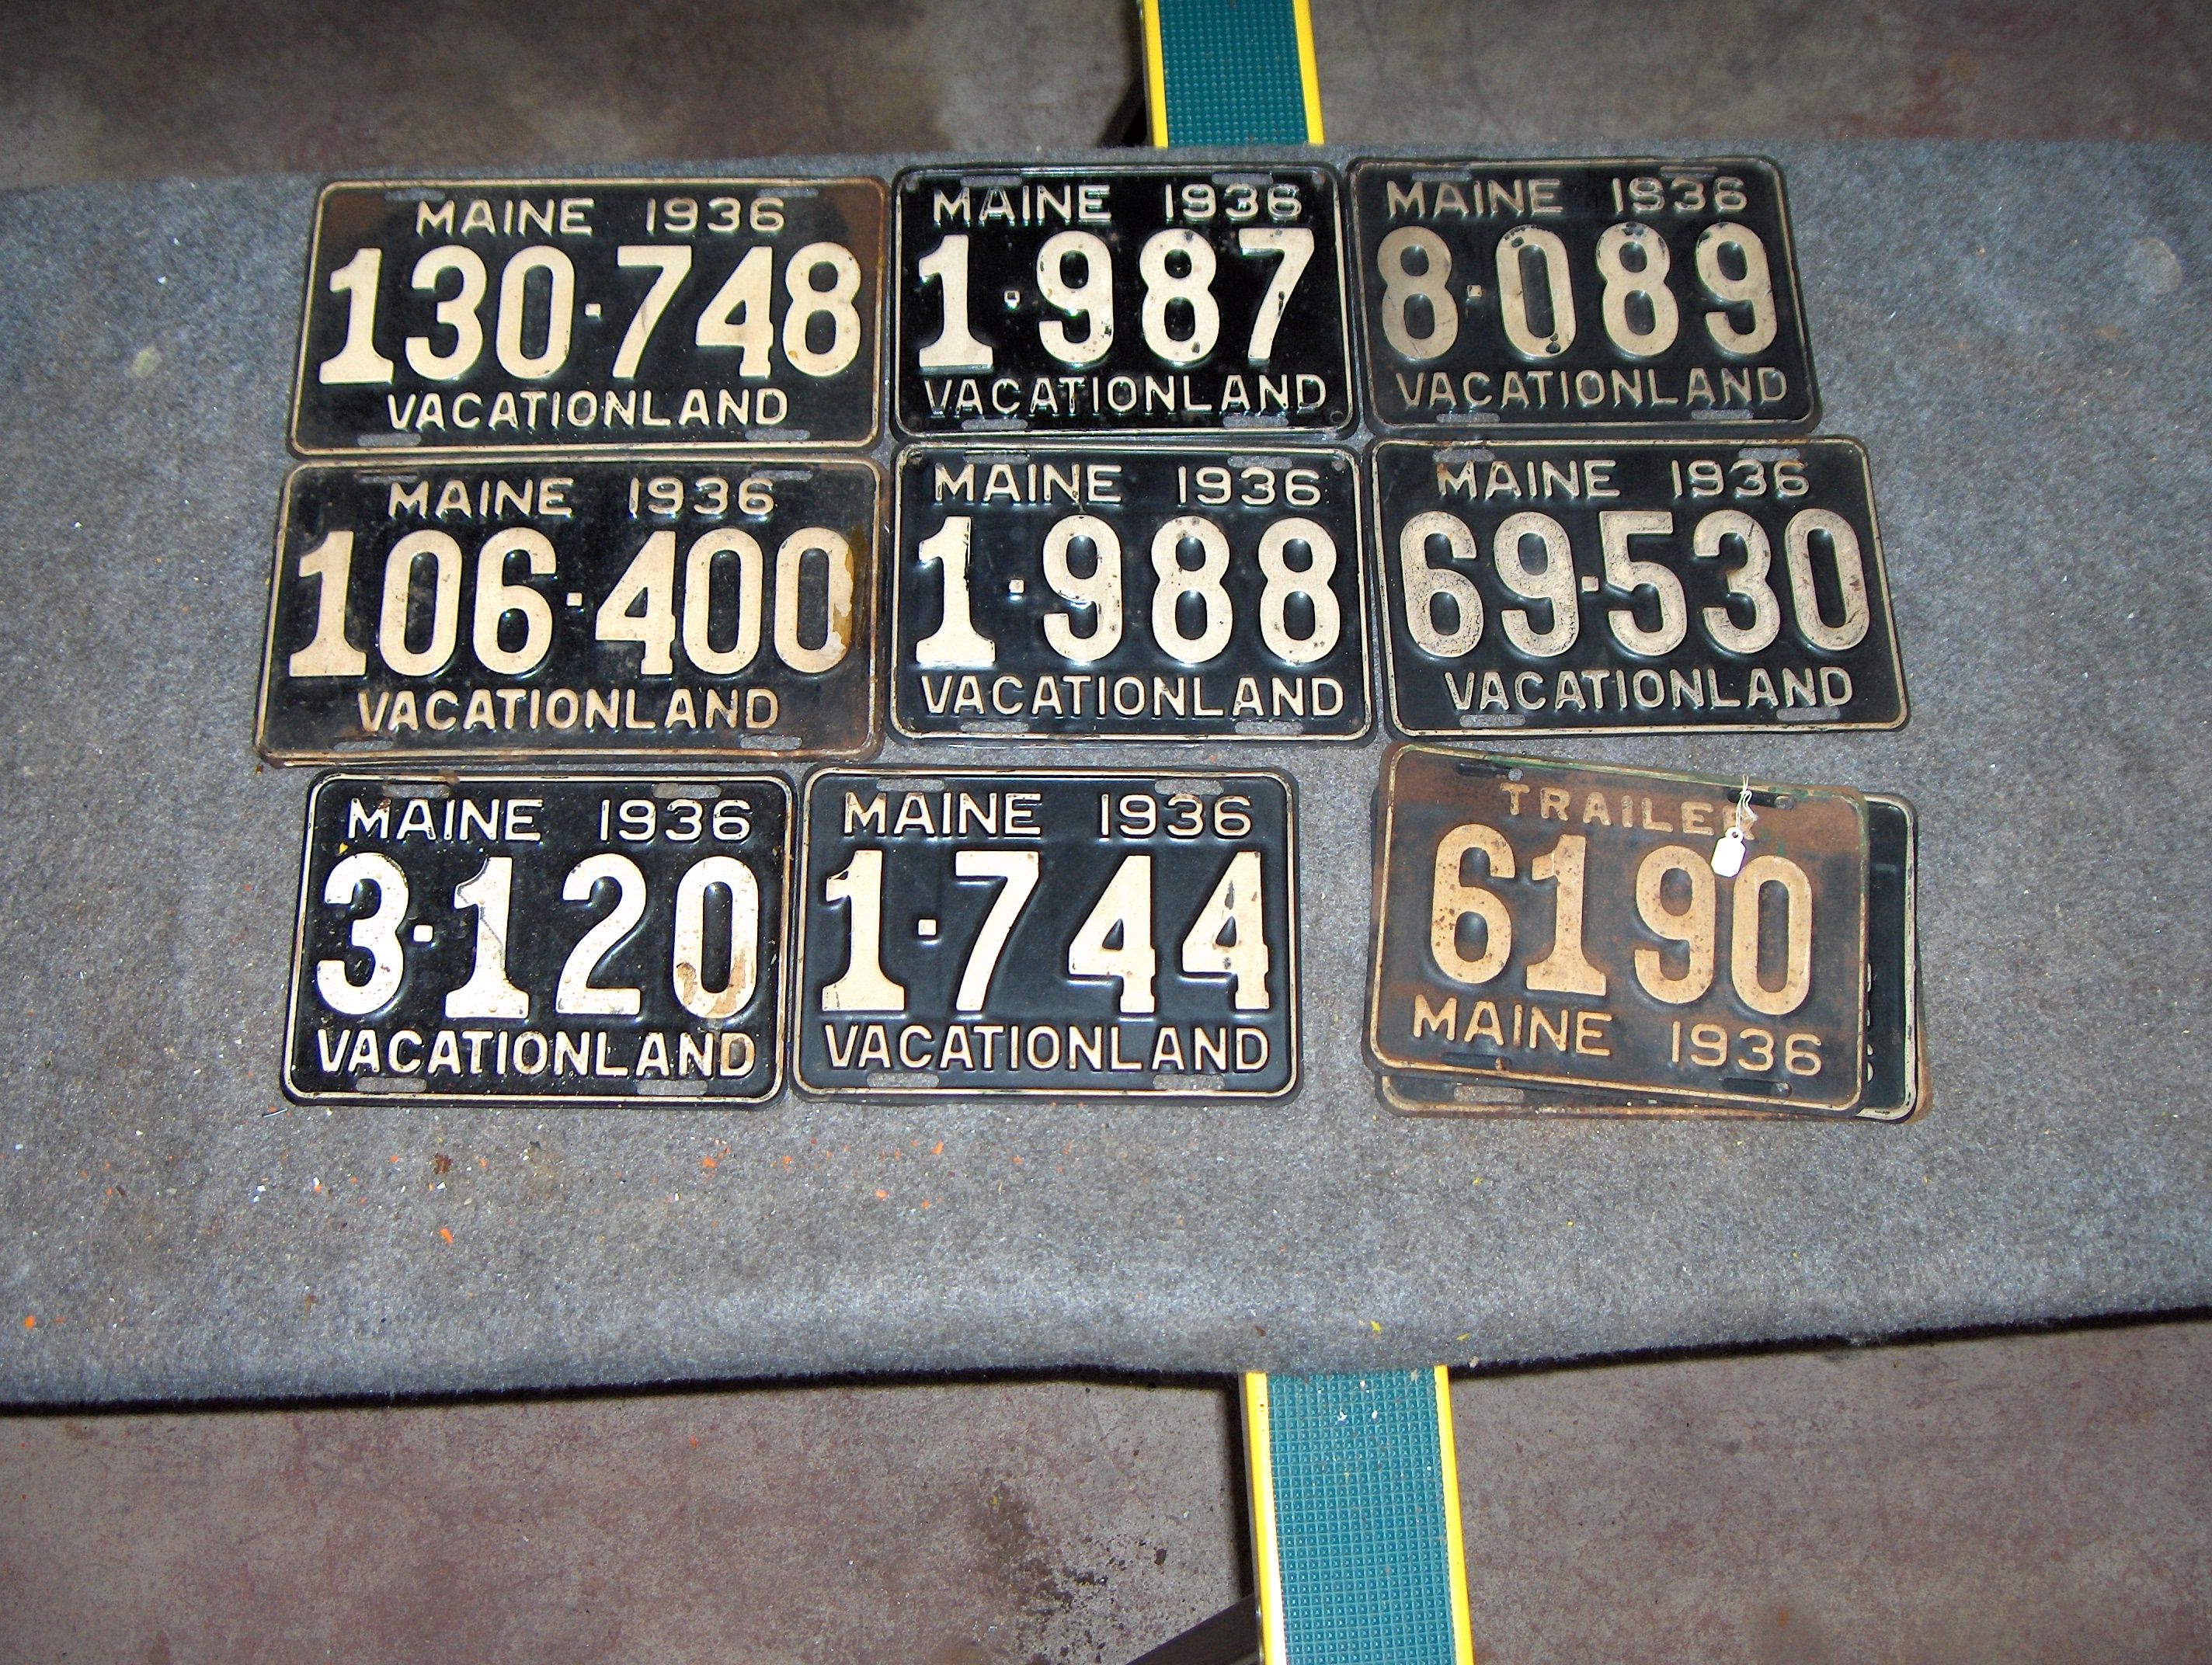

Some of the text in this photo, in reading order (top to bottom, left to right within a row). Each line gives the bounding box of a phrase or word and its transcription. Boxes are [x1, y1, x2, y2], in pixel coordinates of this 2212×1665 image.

[416, 196, 786, 236] MAINE 1936
[933, 183, 1302, 225] MAINE 1936
[1386, 177, 1748, 217] MAINE 1936
[388, 389, 788, 429] VACATIONLAND
[924, 373, 1327, 415] VACATIONLAND
[1396, 367, 1787, 408] VACATIONLAND
[388, 476, 774, 518] MAINE 1936
[934, 464, 1321, 506] MAINE 1936
[1436, 459, 1810, 499] MAINE 1936
[356, 688, 779, 732] VACATIONLAND
[920, 674, 1344, 718] VACATIONLAND
[1444, 667, 1853, 711] VACATIONLAND
[347, 798, 751, 842] MAINE 1936
[843, 792, 1251, 837] MAINE 1936
[1431, 823, 1813, 1017] 6190
[317, 1029, 755, 1076] VACATIONLAND
[825, 1024, 1269, 1072] VACATIONLAND
[1413, 994, 1613, 1057] MAINE
[1671, 1020, 1822, 1077] 1936
